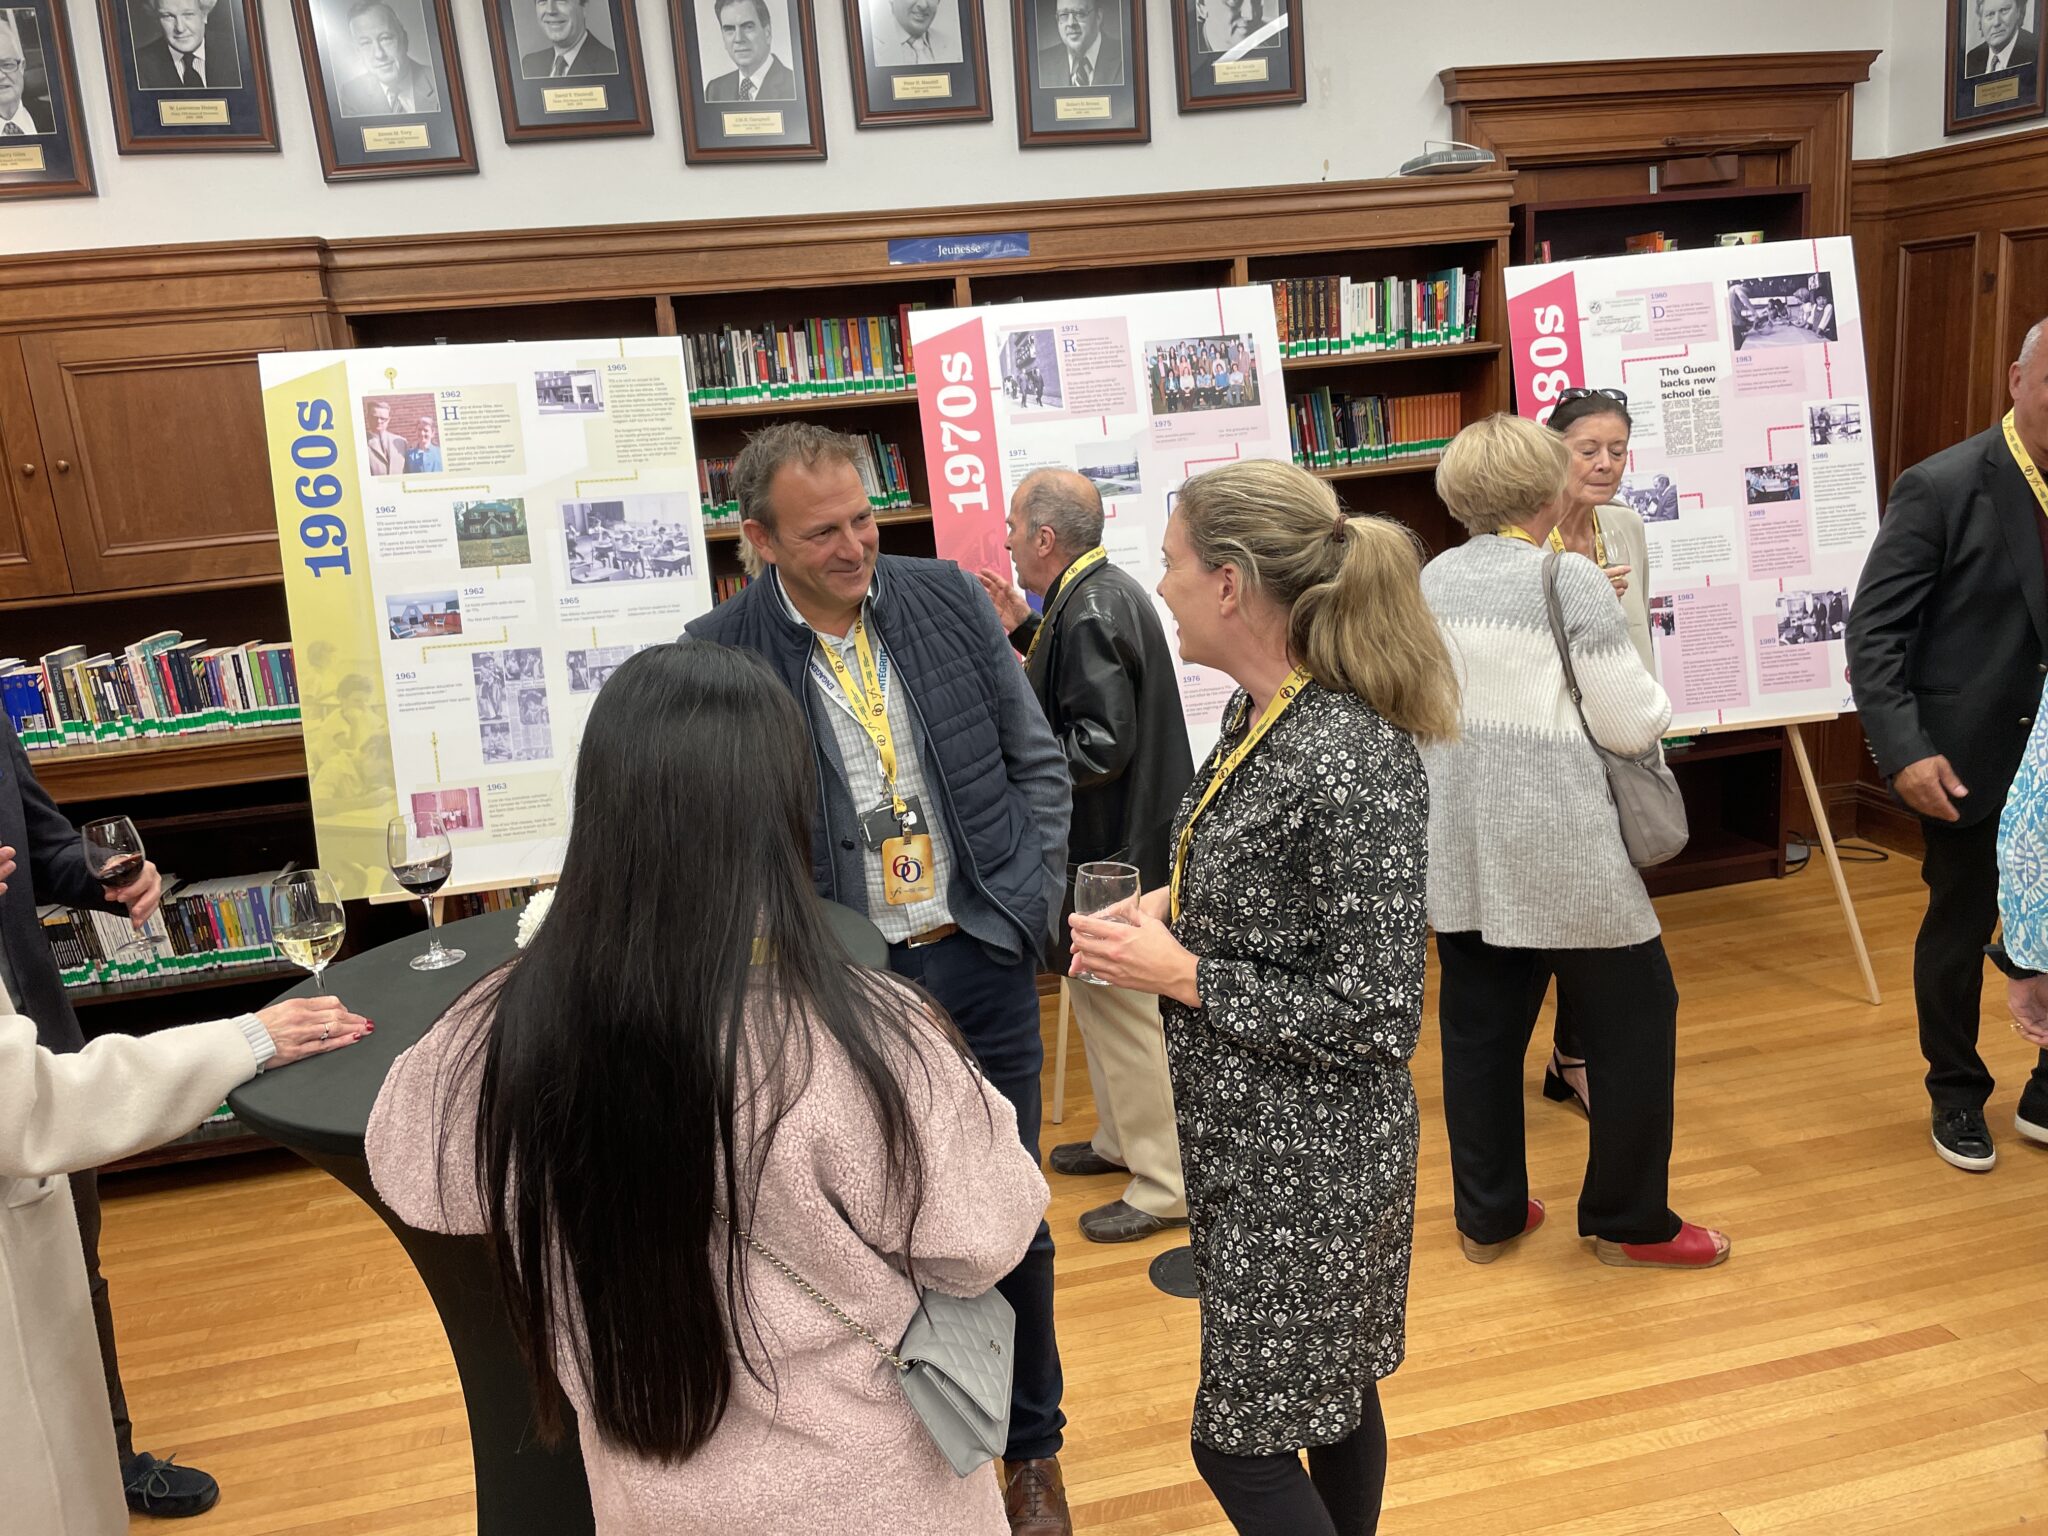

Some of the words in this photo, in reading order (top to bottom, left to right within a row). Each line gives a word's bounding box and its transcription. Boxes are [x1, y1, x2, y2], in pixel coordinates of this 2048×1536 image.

[937, 244, 982, 258] Jeunesse
[1529, 304, 1571, 427] 80s
[1659, 367, 1679, 377] The
[1683, 365, 1716, 374] Queen
[1660, 378, 1690, 388] backs
[1693, 377, 1716, 385] new
[1661, 389, 1695, 400] school
[1698, 387, 1711, 396] tie
[936, 351, 989, 514] 1970s
[290, 398, 352, 579] 1960s
[1183, 675, 1201, 683] 1976
[893, 854, 922, 883] 60
